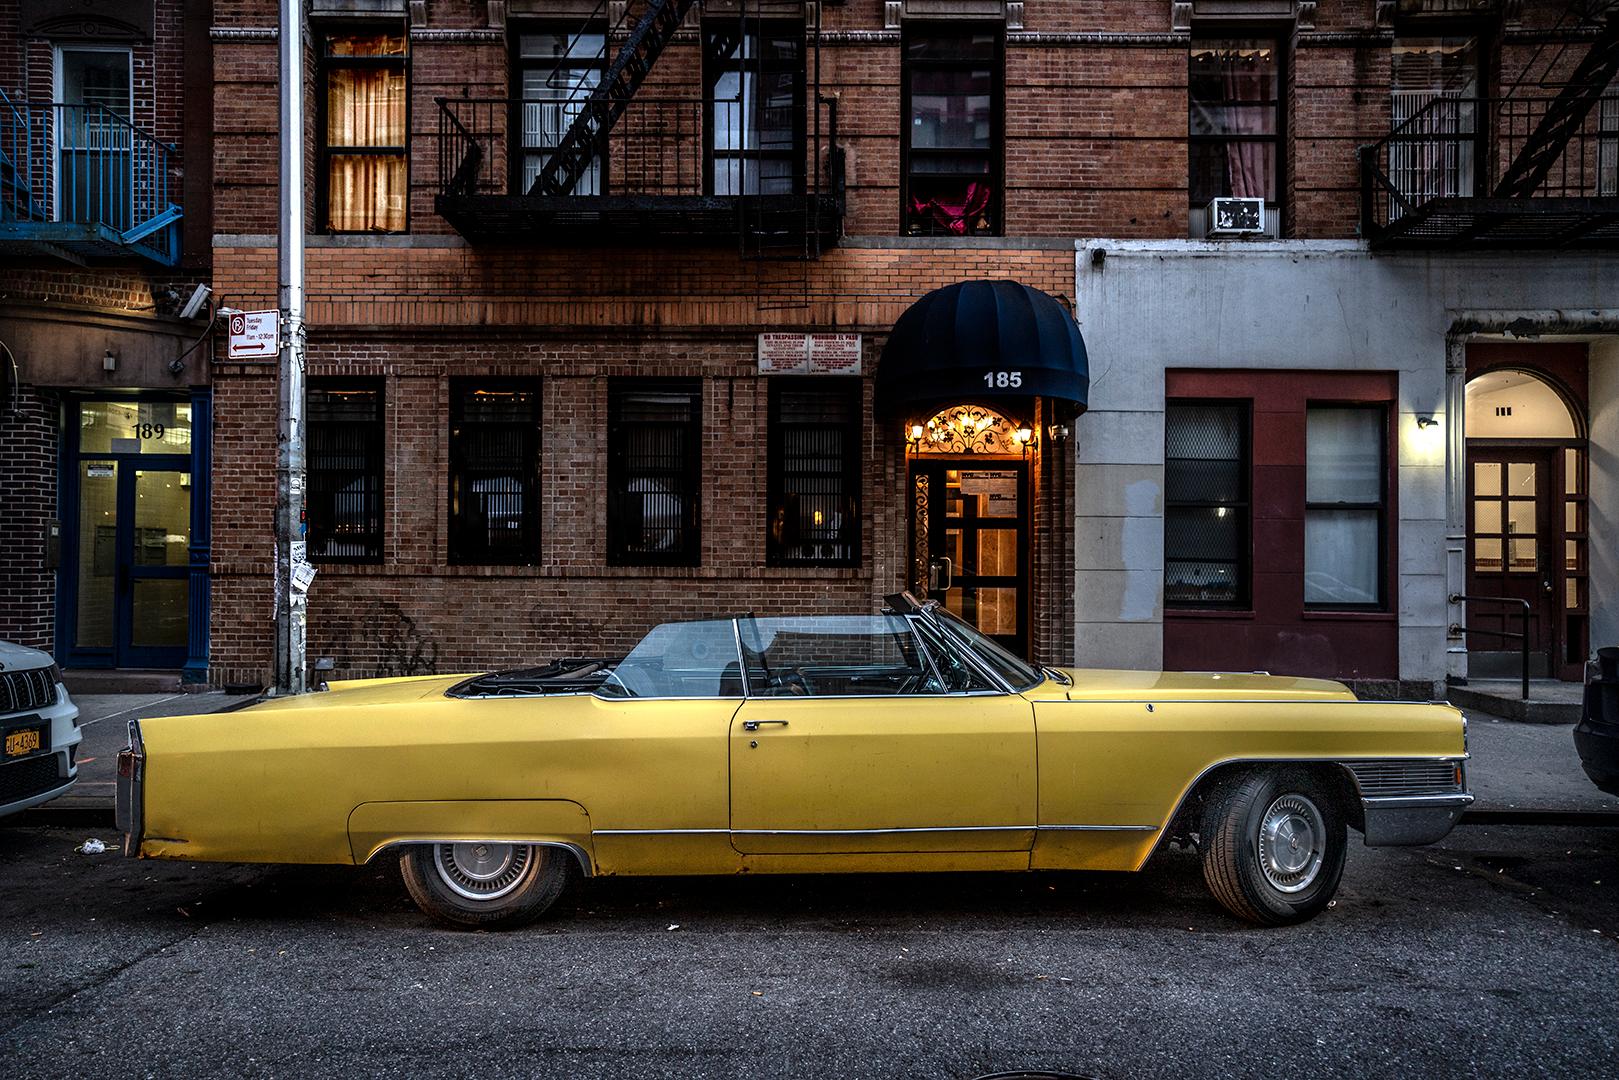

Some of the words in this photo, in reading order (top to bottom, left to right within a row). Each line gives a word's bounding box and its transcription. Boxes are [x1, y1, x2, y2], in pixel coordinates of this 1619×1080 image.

[246, 317, 262, 325] Tuesday
[983, 371, 1022, 388] 185
[132, 423, 165, 440] 189
